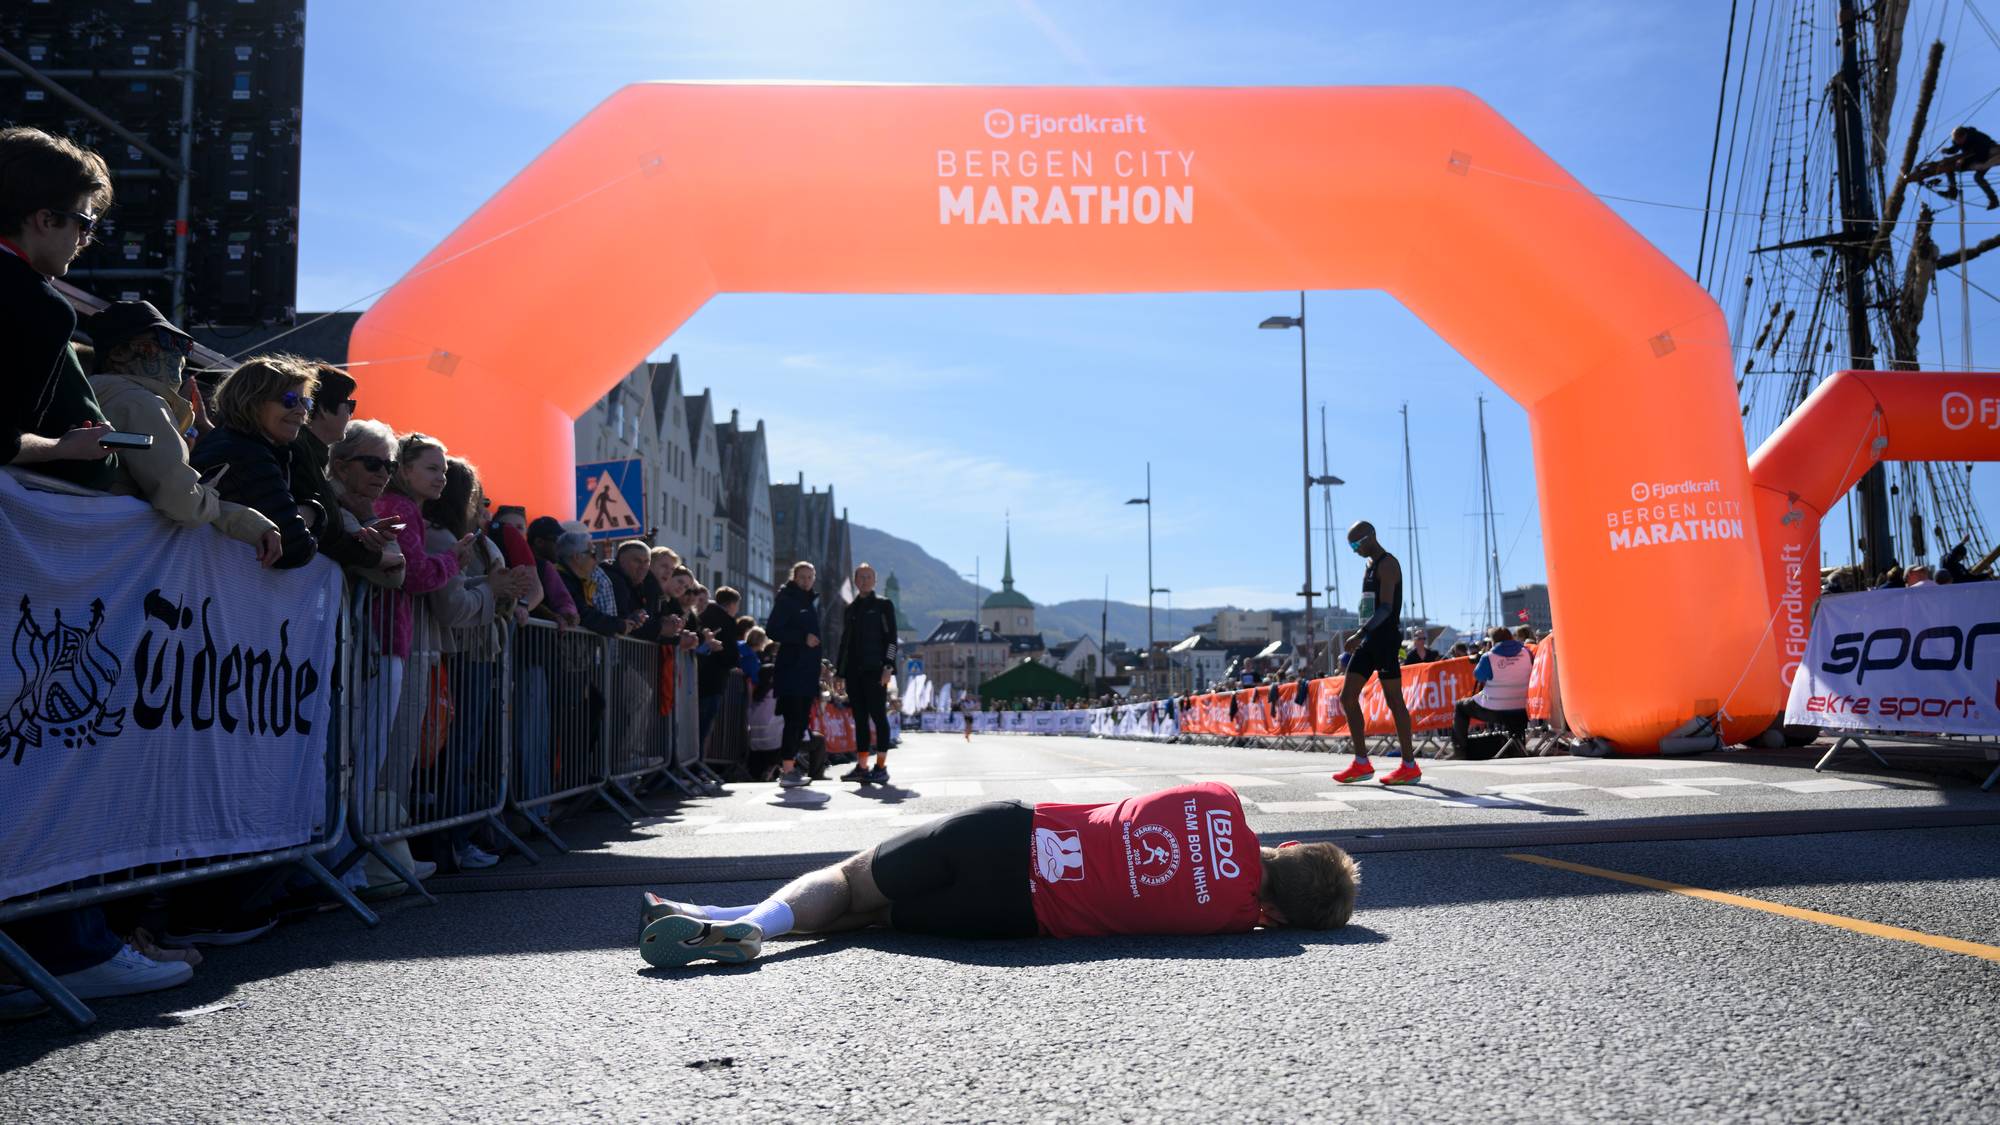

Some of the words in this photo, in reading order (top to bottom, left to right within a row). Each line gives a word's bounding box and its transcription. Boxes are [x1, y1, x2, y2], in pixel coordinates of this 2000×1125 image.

[1020, 112, 1147, 138] Fjordkraft
[937, 149, 1093, 177] BERGEN
[1114, 149, 1196, 177] CITY
[938, 185, 1194, 225] MARATHON
[1652, 479, 1720, 499] Fjordkraft
[1607, 502, 1697, 528] BERGEN
[1705, 500, 1741, 516] CITY
[1609, 518, 1743, 551] MARATHON
[1781, 544, 1808, 655] Fjordkraft
[133, 588, 319, 738] Tidende
[1184, 798, 1196, 831] TEAM
[1186, 834, 1203, 863] BDO
[1192, 866, 1211, 905] NHHS
